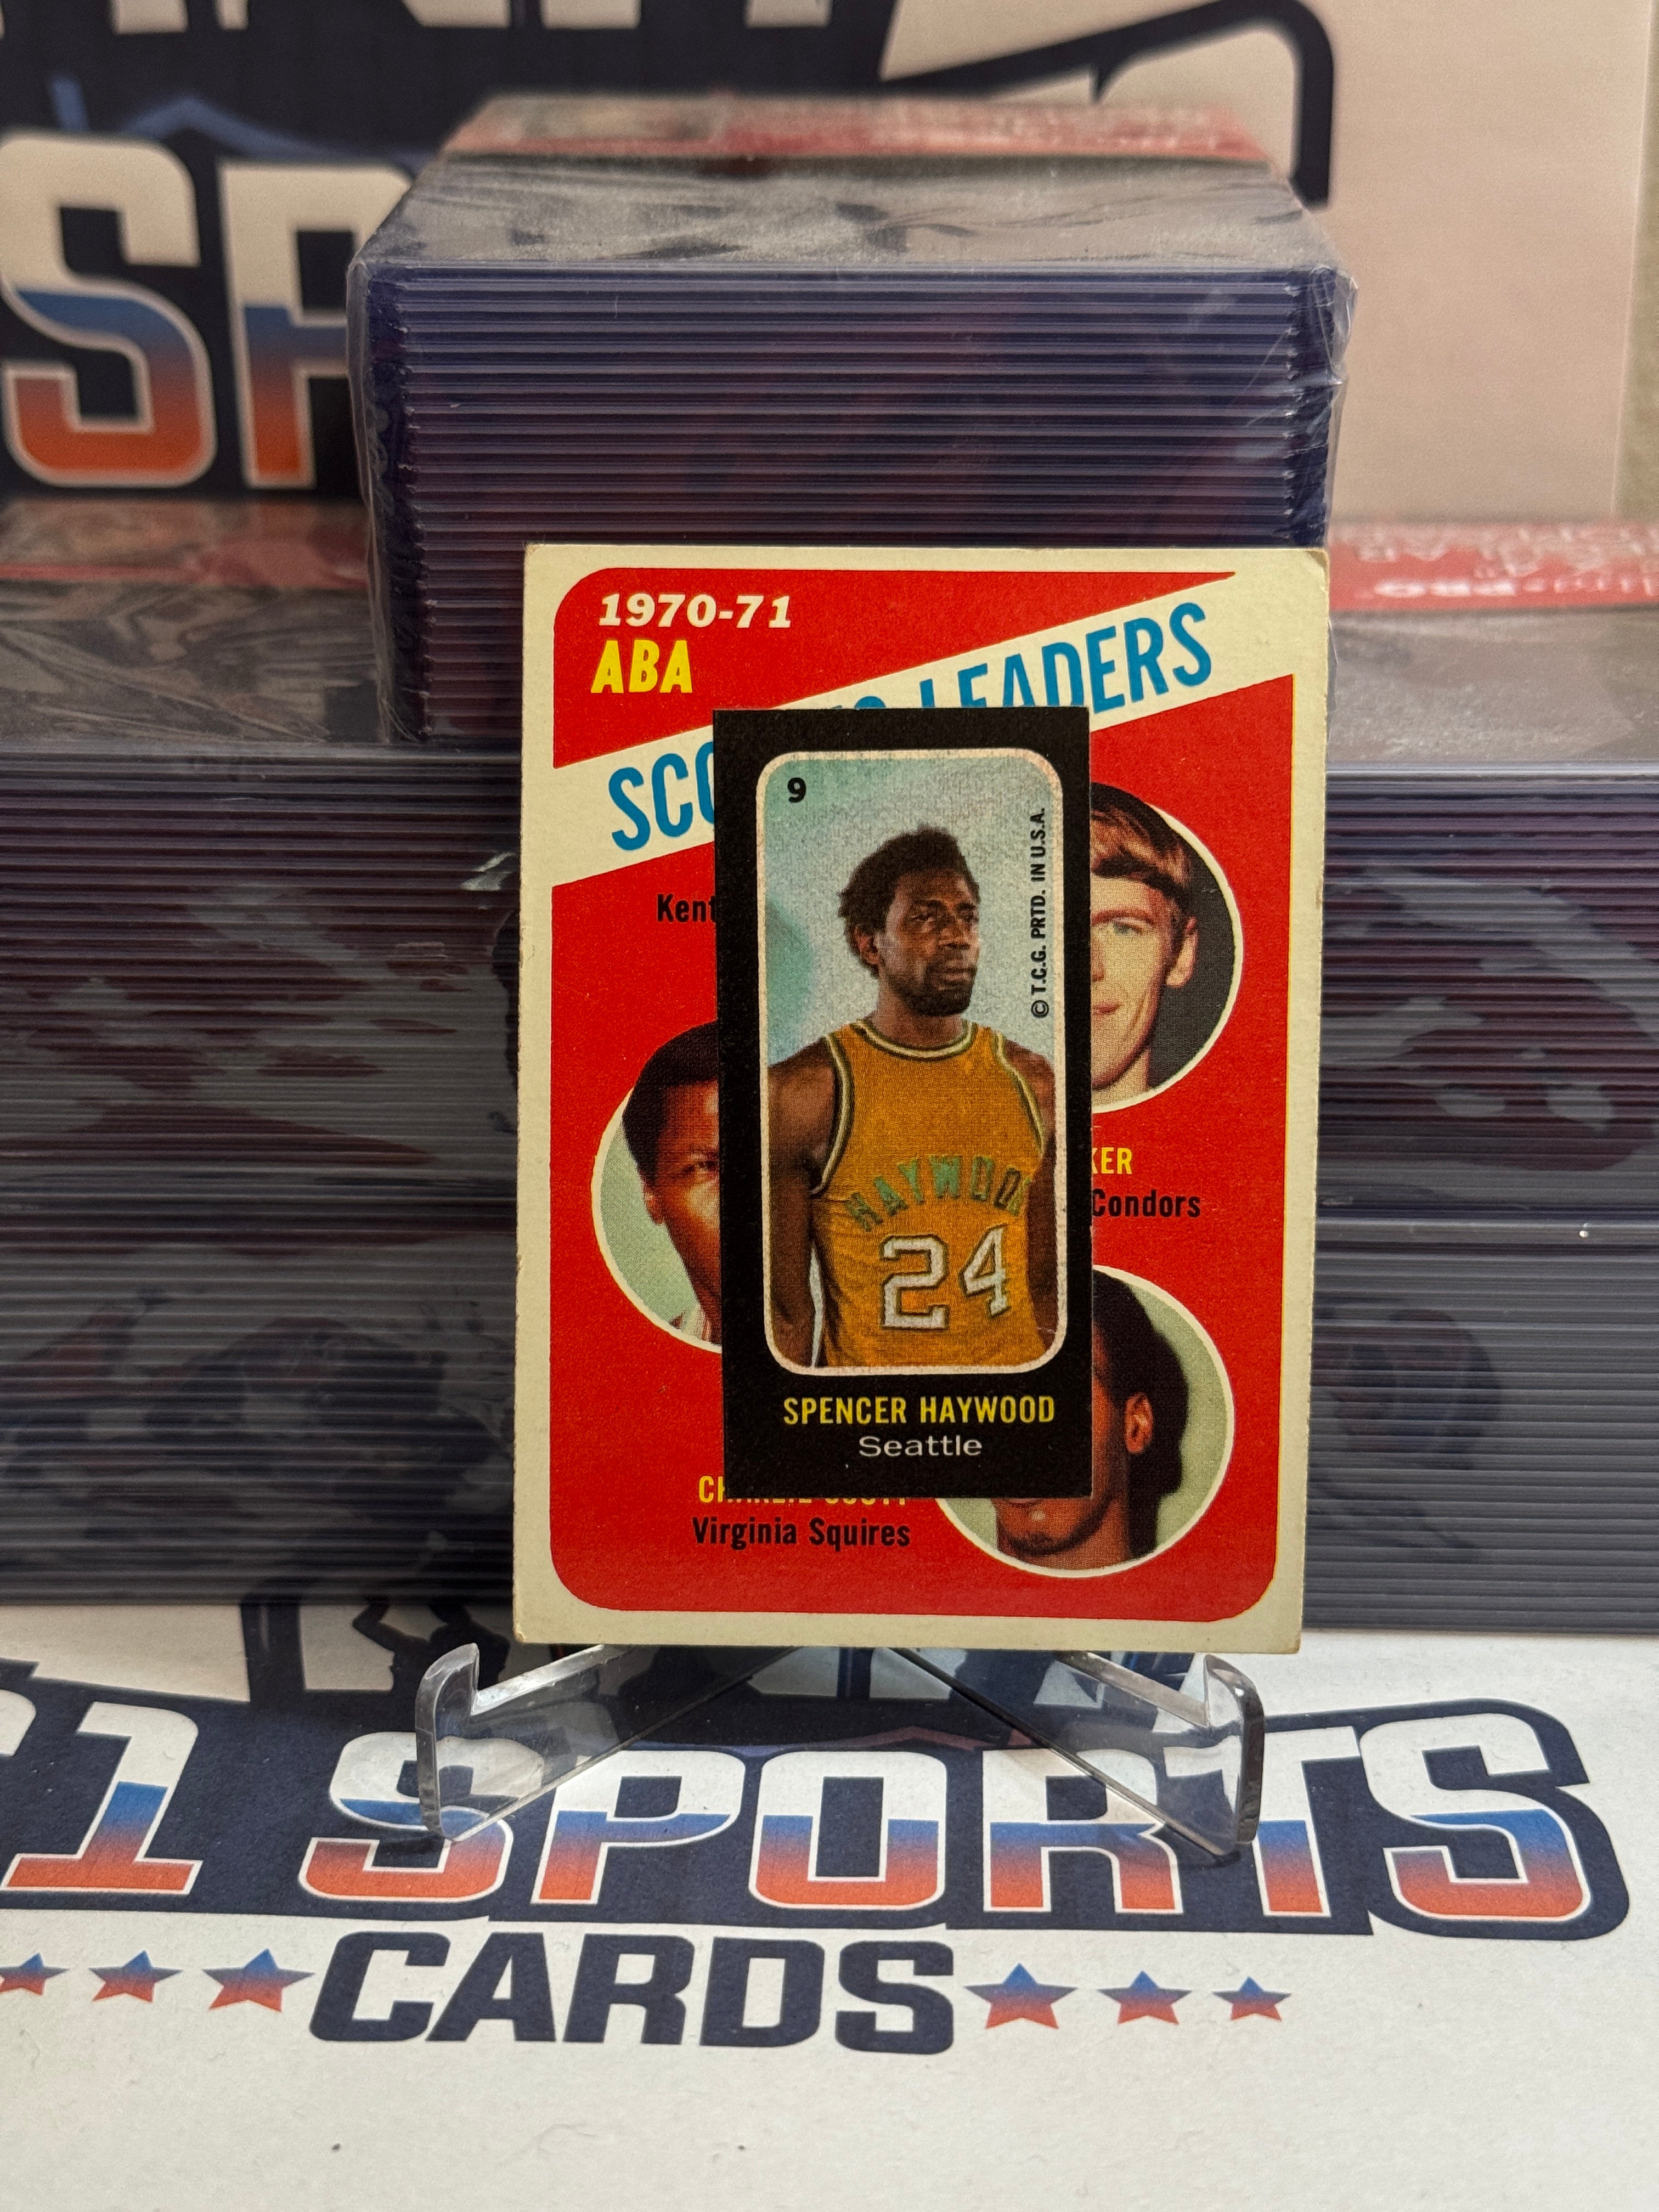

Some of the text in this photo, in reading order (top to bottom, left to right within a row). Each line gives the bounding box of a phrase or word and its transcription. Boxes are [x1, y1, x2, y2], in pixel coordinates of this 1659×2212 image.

[598, 592, 792, 629] 1970-71
[590, 639, 693, 694] ABA
[787, 776, 807, 804] 9
[1029, 807, 1046, 859] U.S.A.
[1030, 863, 1046, 882] IN
[1029, 889, 1046, 940] PRTD.
[1092, 1188, 1201, 1218] Condors
[881, 1223, 1011, 1330] 24
[783, 1395, 1054, 1425] SPENCER HAYWOOD
[859, 1435, 983, 1457] Seattle
[692, 1516, 911, 1553] Virginia Squires
[298, 1712, 1592, 1922] SPORTS
[309, 1931, 955, 2056] CARDS
